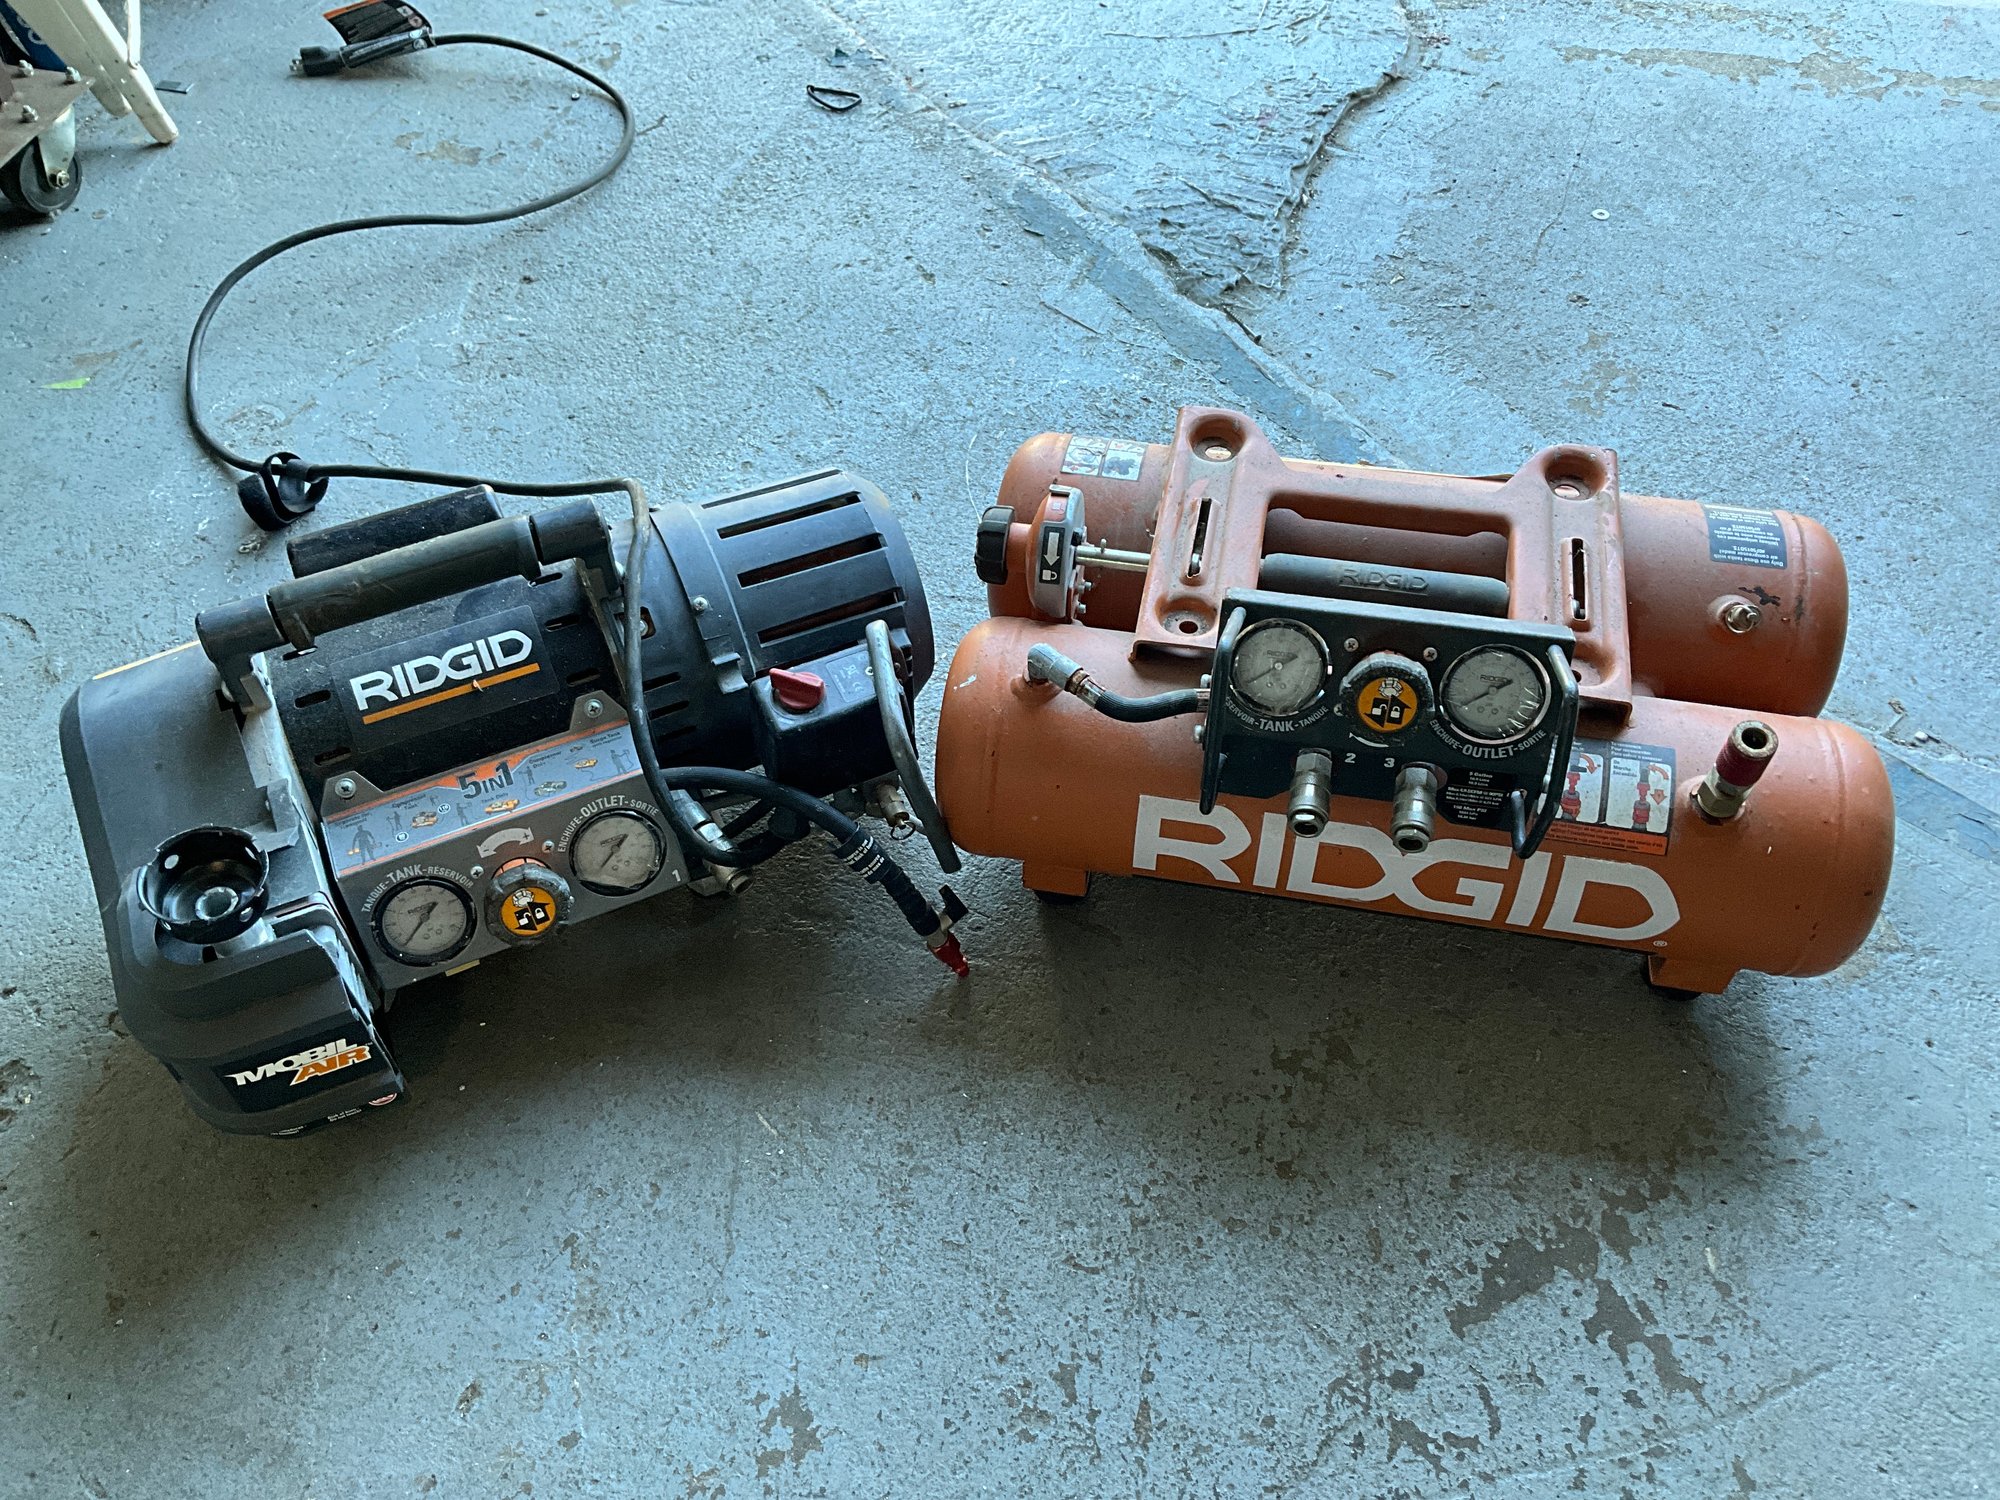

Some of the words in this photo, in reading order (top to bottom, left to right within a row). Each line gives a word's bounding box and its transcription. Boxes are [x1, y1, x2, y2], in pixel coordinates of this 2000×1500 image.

[1339, 568, 1430, 591] RIDGID
[349, 629, 533, 711] RIDGID
[1345, 752, 1356, 764] 2
[1384, 757, 1395, 768] 3
[672, 869, 681, 882] 1
[1132, 795, 1681, 942] RIDGID
[289, 1045, 372, 1087] AIR
